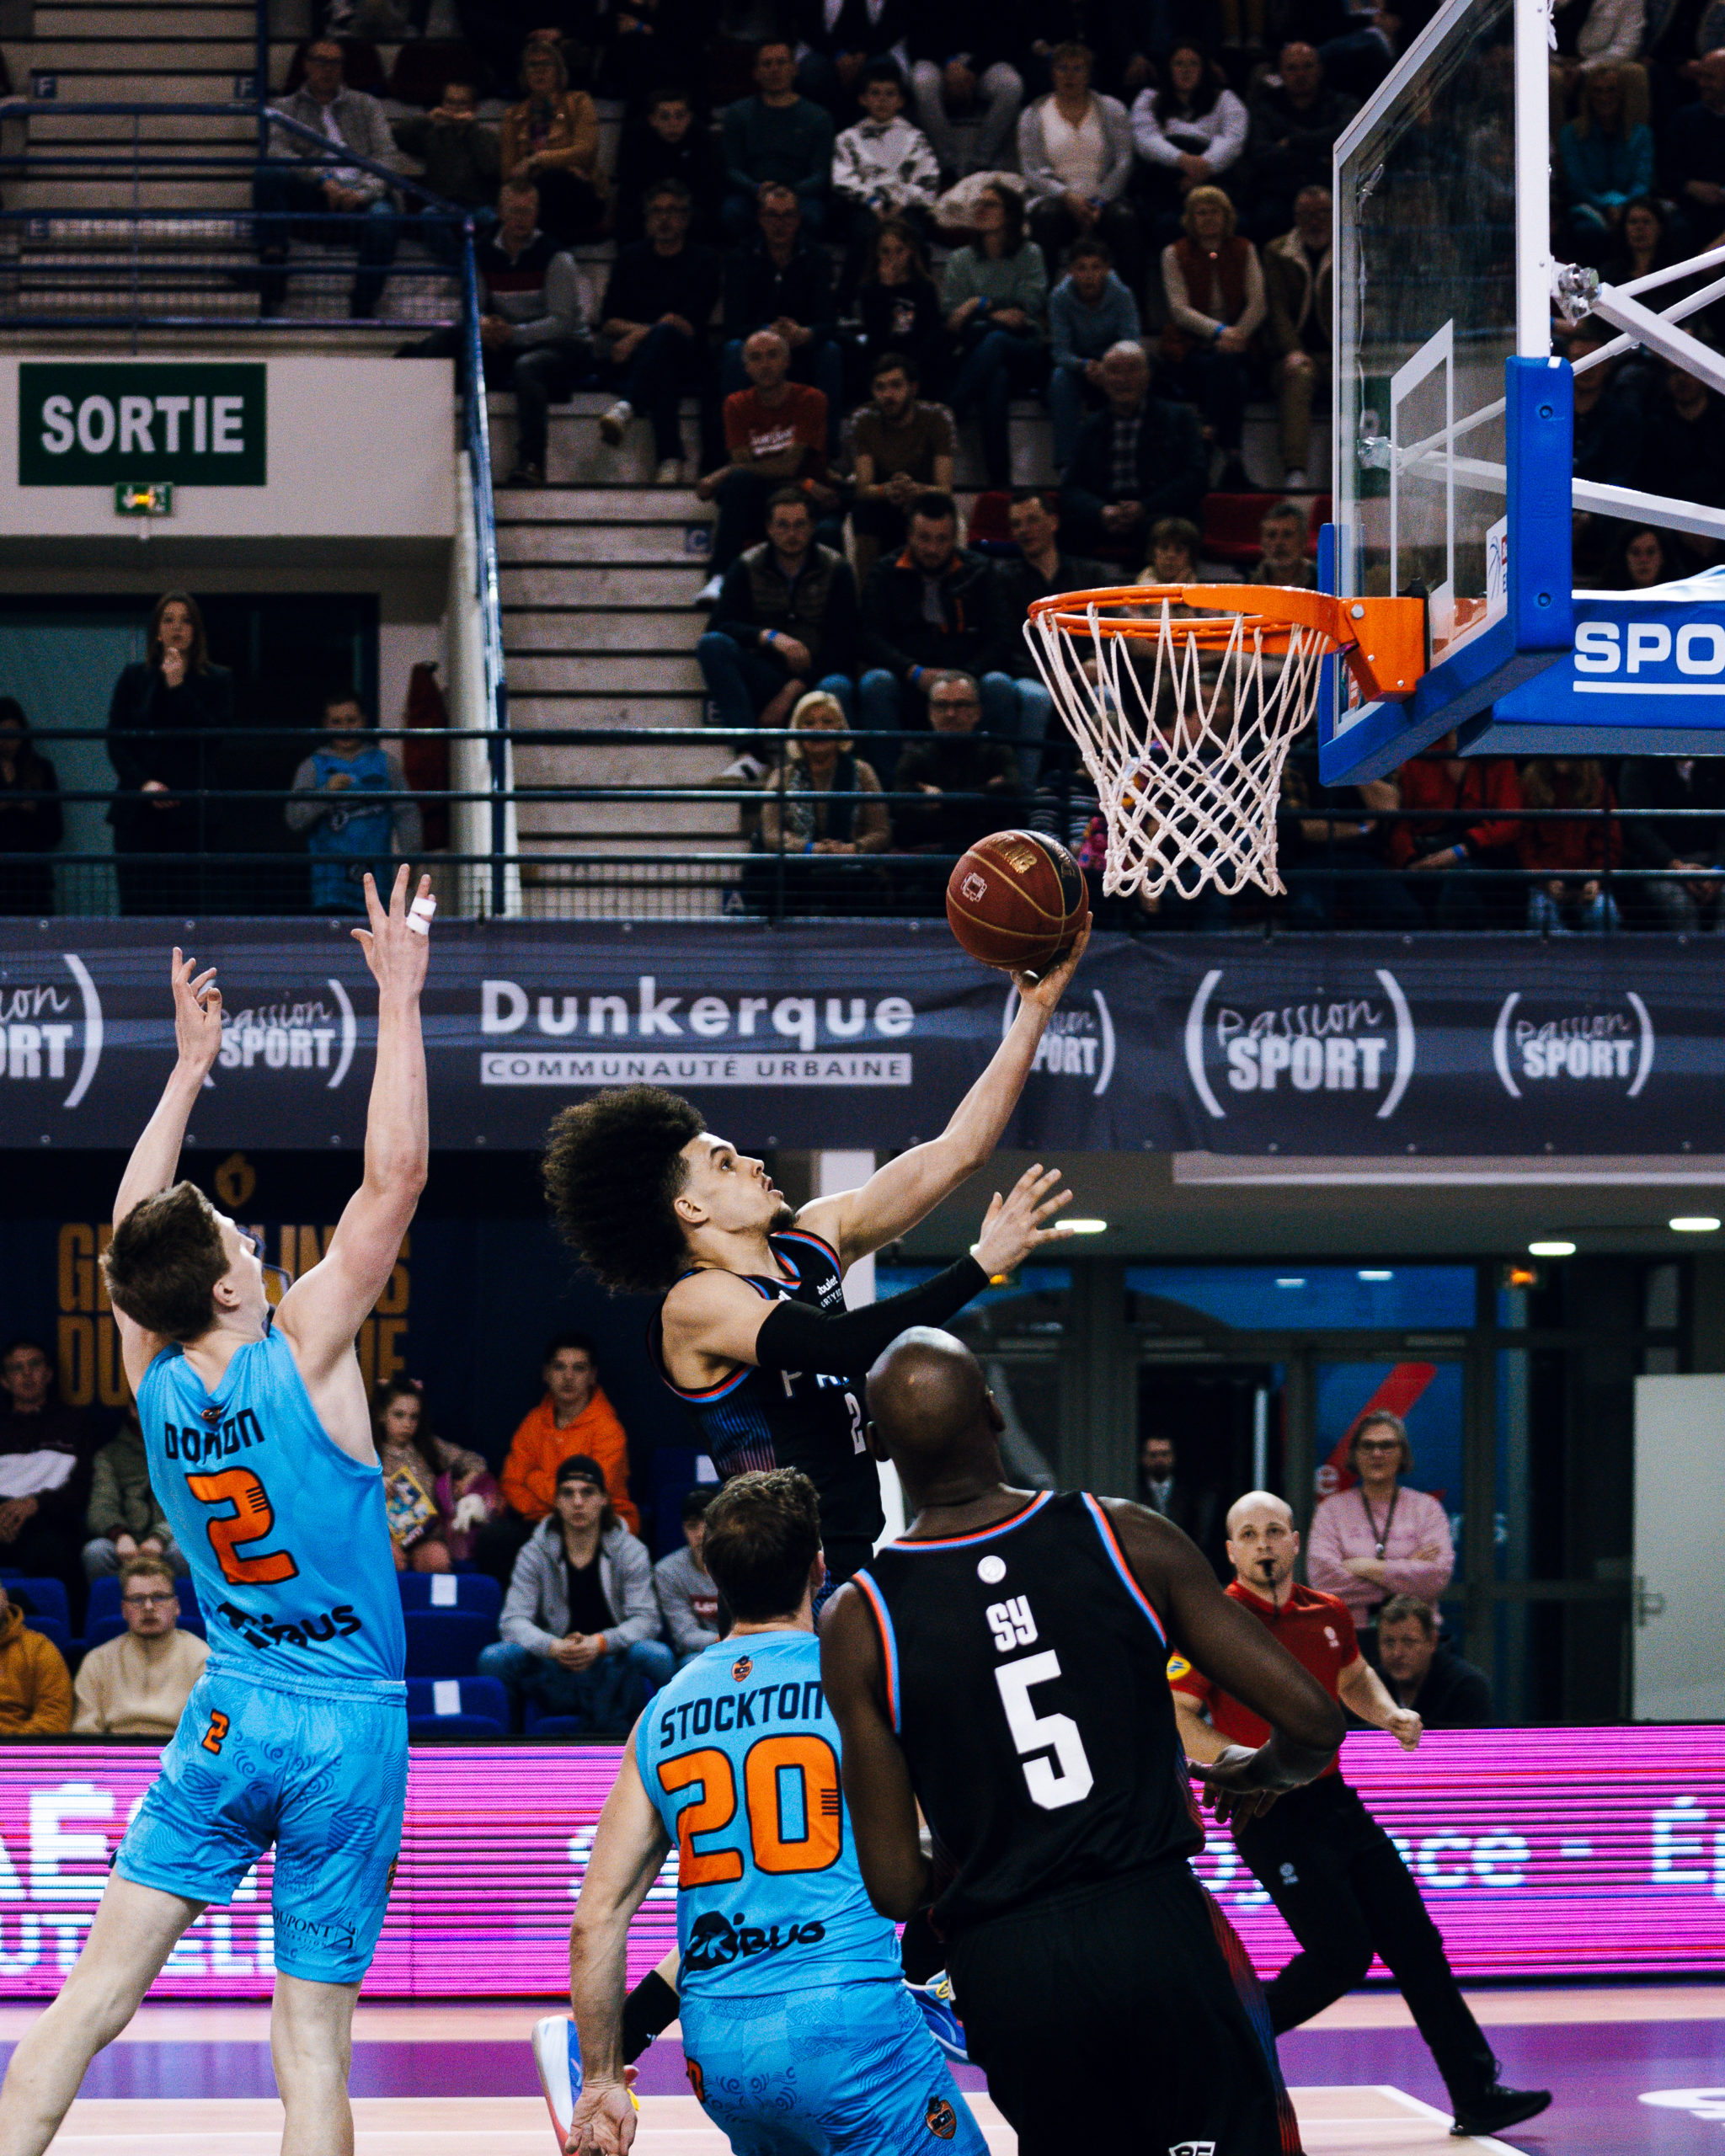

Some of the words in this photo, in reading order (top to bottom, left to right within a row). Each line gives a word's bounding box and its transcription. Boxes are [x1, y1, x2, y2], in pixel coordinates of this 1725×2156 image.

[41, 394, 245, 455] SORTIE
[1574, 622, 1725, 675] SPO
[481, 976, 915, 1052] Dunkerque
[0, 1024, 73, 1079] RT
[218, 1027, 336, 1069] SPORT
[488, 1054, 738, 1078] COMMUNAUTÉ
[757, 1059, 904, 1078] URBAINE
[1029, 1033, 1098, 1075] PORT
[1227, 1036, 1387, 1091] SPORT
[1522, 1040, 1635, 1078] SPORT
[184, 1465, 300, 1586] 2
[985, 1594, 1039, 1653] SY
[200, 1708, 231, 1756] 2
[660, 1680, 823, 1750] STOCKTON
[994, 1648, 1095, 1811] 5
[656, 1731, 843, 1892] 20
